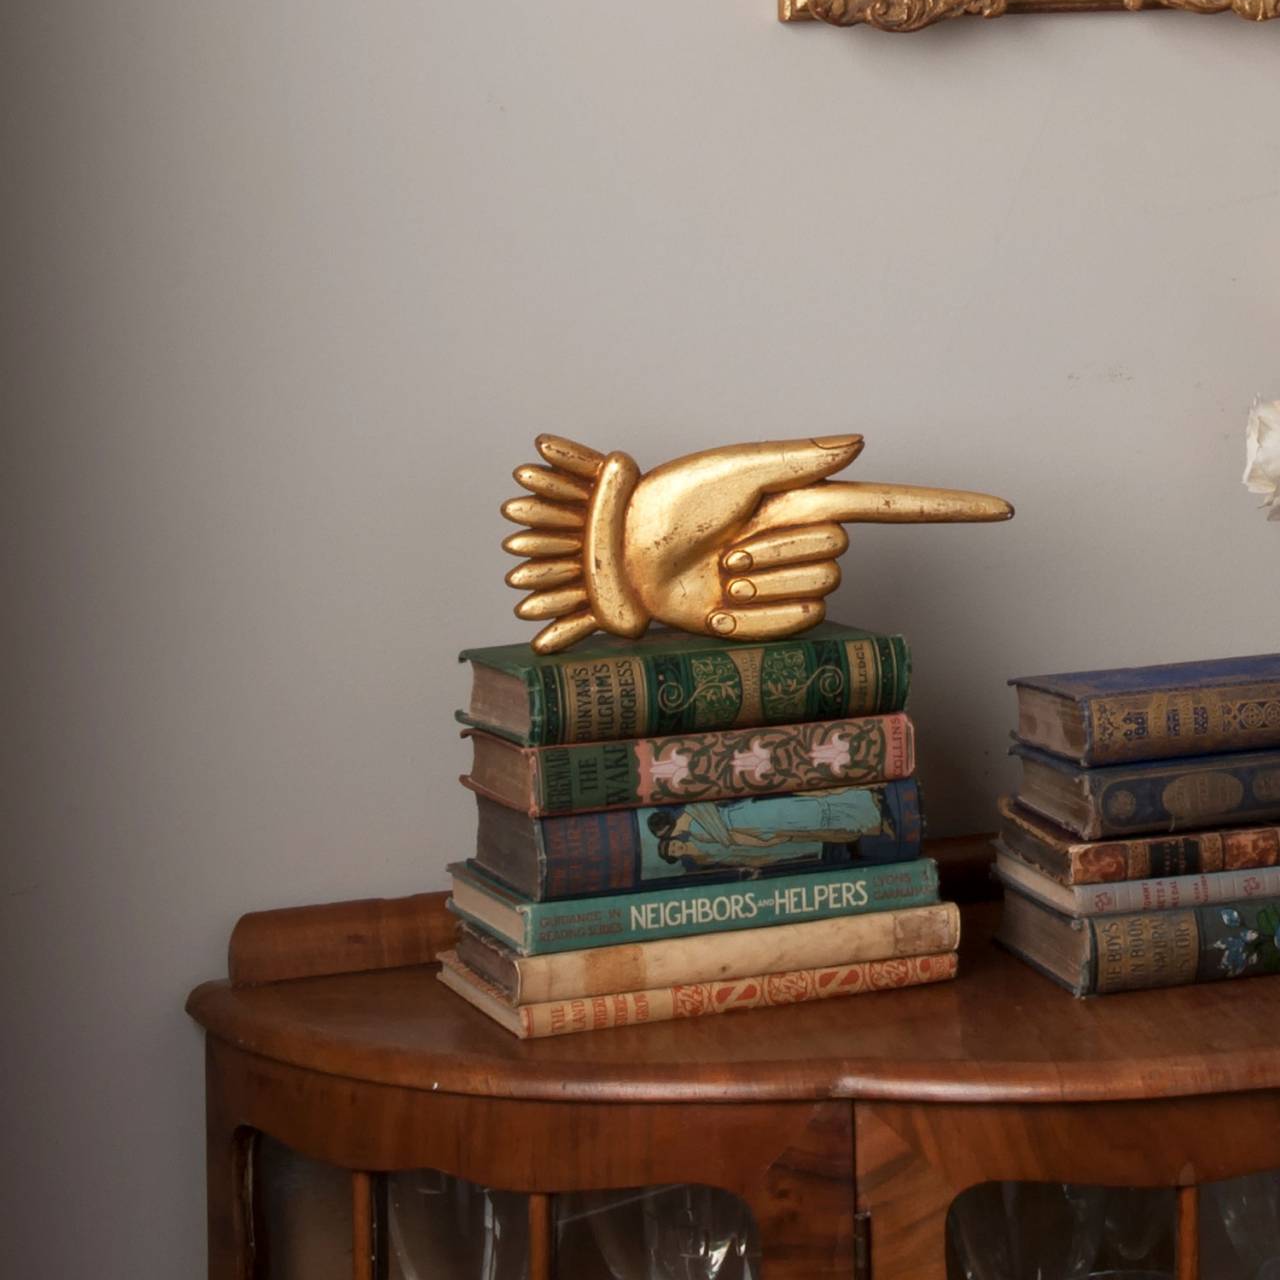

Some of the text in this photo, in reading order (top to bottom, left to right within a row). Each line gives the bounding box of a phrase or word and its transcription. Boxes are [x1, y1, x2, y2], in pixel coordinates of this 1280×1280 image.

[889, 717, 903, 777] COLLINS
[579, 756, 599, 793] THE
[603, 743, 631, 806] WAKE
[630, 880, 869, 931] NEIGHBORS AND HELPERS
[1127, 918, 1145, 960] BOOK
[551, 1005, 565, 1034] THE
[570, 999, 585, 1031] LAND
